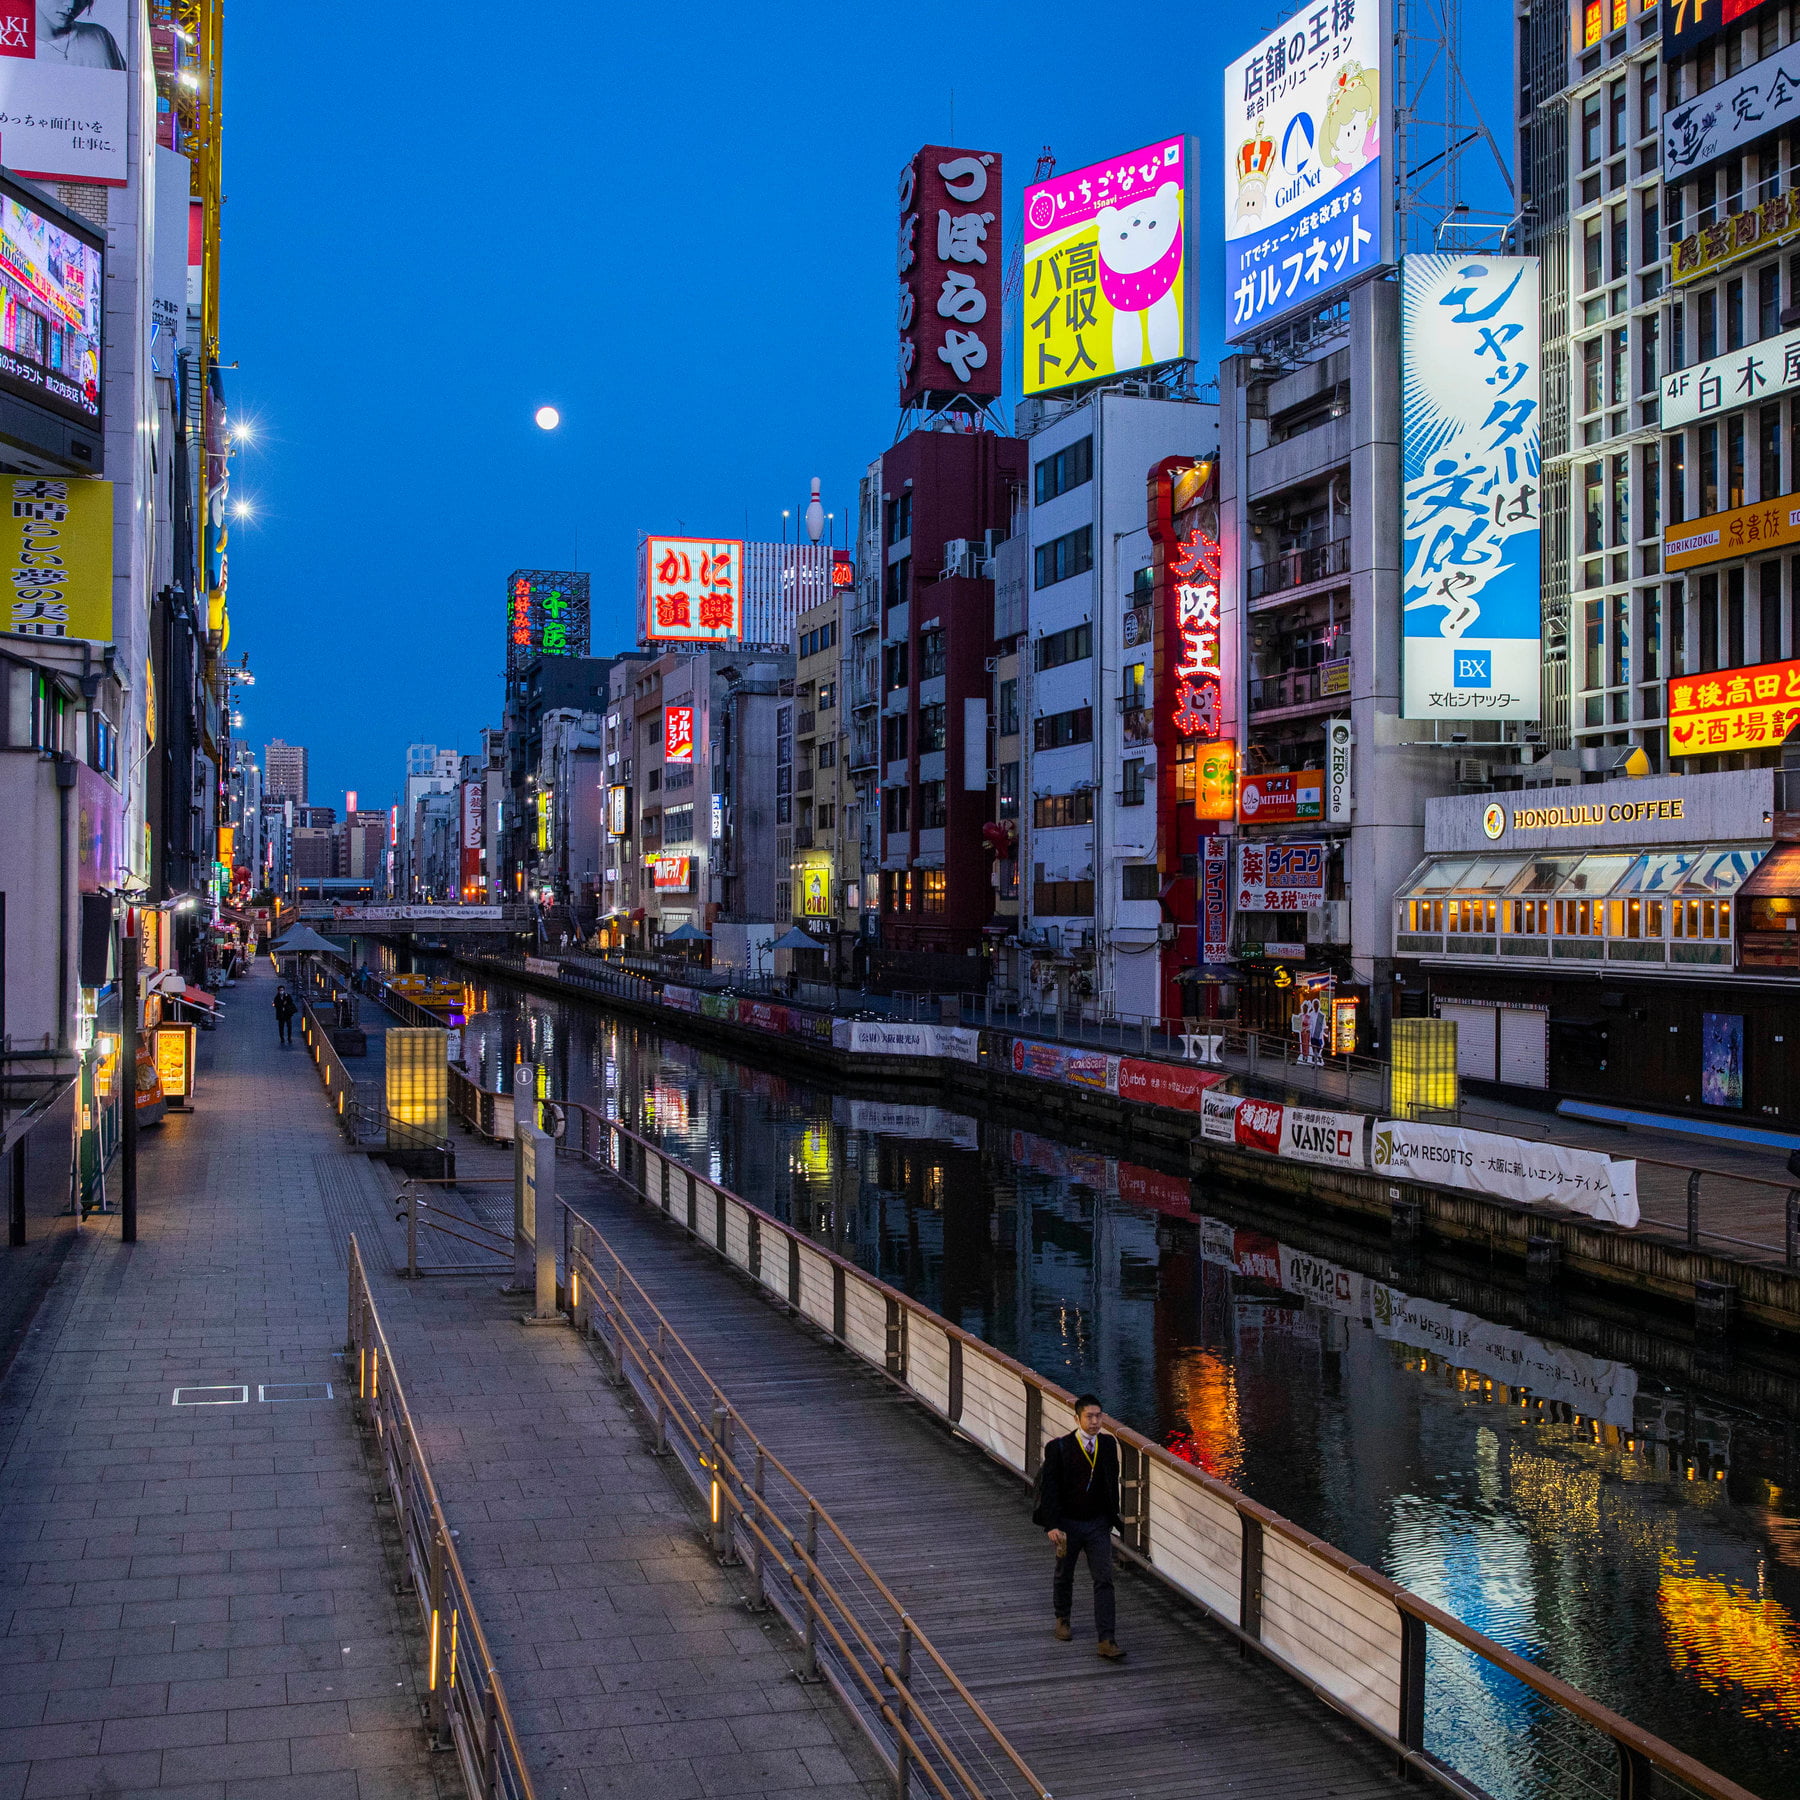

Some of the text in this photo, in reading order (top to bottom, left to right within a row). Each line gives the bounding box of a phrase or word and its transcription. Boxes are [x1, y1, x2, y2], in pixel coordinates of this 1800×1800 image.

[1244, 0, 1356, 101] 店舗の王様
[72, 136, 117, 153] 仕事に。
[1056, 156, 1162, 210] いちごなび
[1093, 194, 1118, 210] 15navi
[1240, 186, 1363, 271] ITでチェーン店を改革する
[938, 154, 995, 383] づぼらや
[1234, 214, 1372, 325] ガルフネット
[1030, 250, 1063, 385] バイト
[1065, 240, 1097, 377] 高収入
[1667, 373, 1690, 399] 4F
[1666, 535, 1714, 554] TORIKIZOKU
[656, 548, 733, 589] かに
[542, 591, 568, 647] 千房
[1459, 659, 1487, 677] BX
[1671, 669, 1800, 713] 豊後高田と
[679, 710, 690, 742] ツルハ
[1696, 711, 1768, 745] 酒場
[1772, 710, 1785, 738] 全品
[1333, 747, 1344, 784] ZERO
[1260, 794, 1296, 805] MITHILA
[1297, 805, 1304, 814] 2F
[1513, 799, 1685, 829] HONOLULU COFFEE
[1243, 846, 1263, 886] 薬
[1268, 848, 1321, 873] ダイコク
[1208, 862, 1223, 914] ダイコク
[1264, 891, 1297, 909] 免税
[1298, 892, 1322, 900] Tax-Free
[1205, 944, 1226, 955] 免税
[1292, 1123, 1336, 1153] VANS
[1391, 1142, 1419, 1159] MGM
[1422, 1145, 1473, 1167] RESORTS
